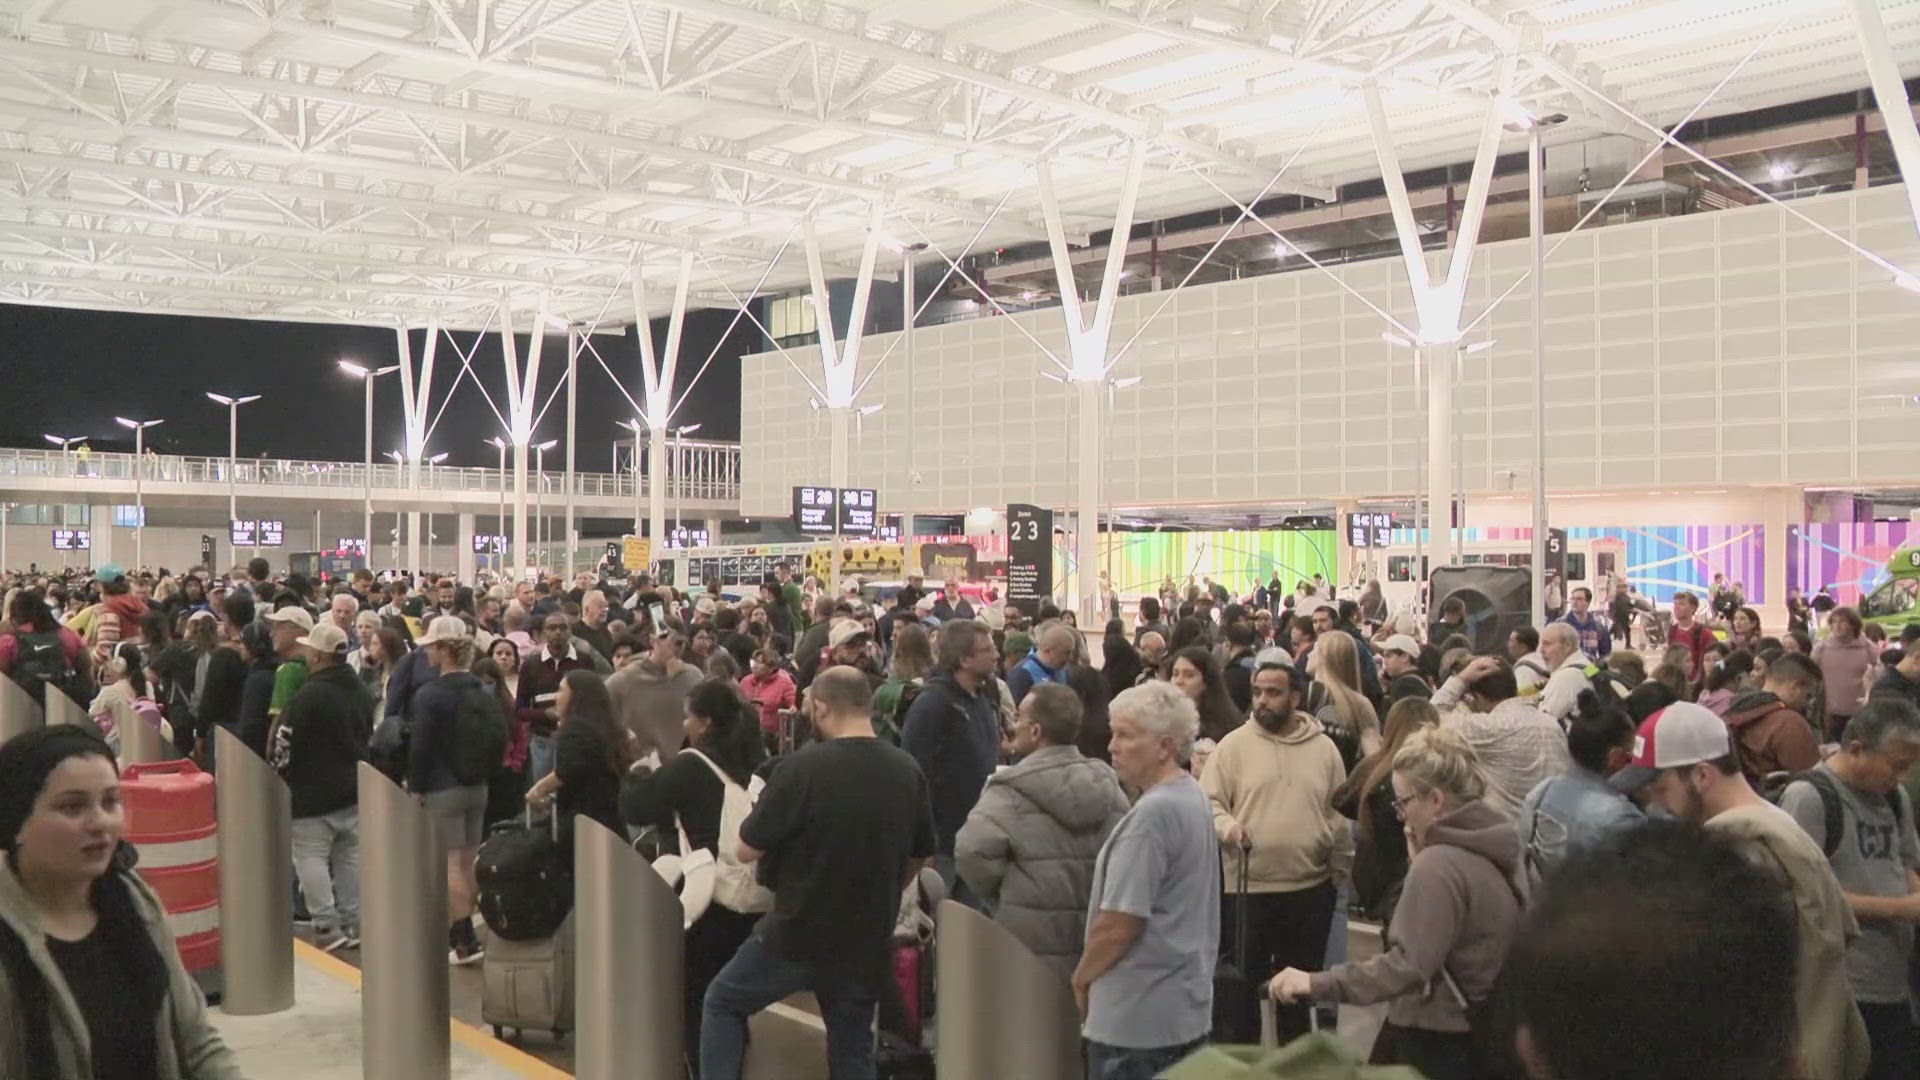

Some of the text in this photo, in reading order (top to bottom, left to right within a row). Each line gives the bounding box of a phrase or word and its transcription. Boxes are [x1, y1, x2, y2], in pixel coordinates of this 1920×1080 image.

[1011, 520, 1038, 541] 2 3
[1550, 538, 1560, 553] 5
